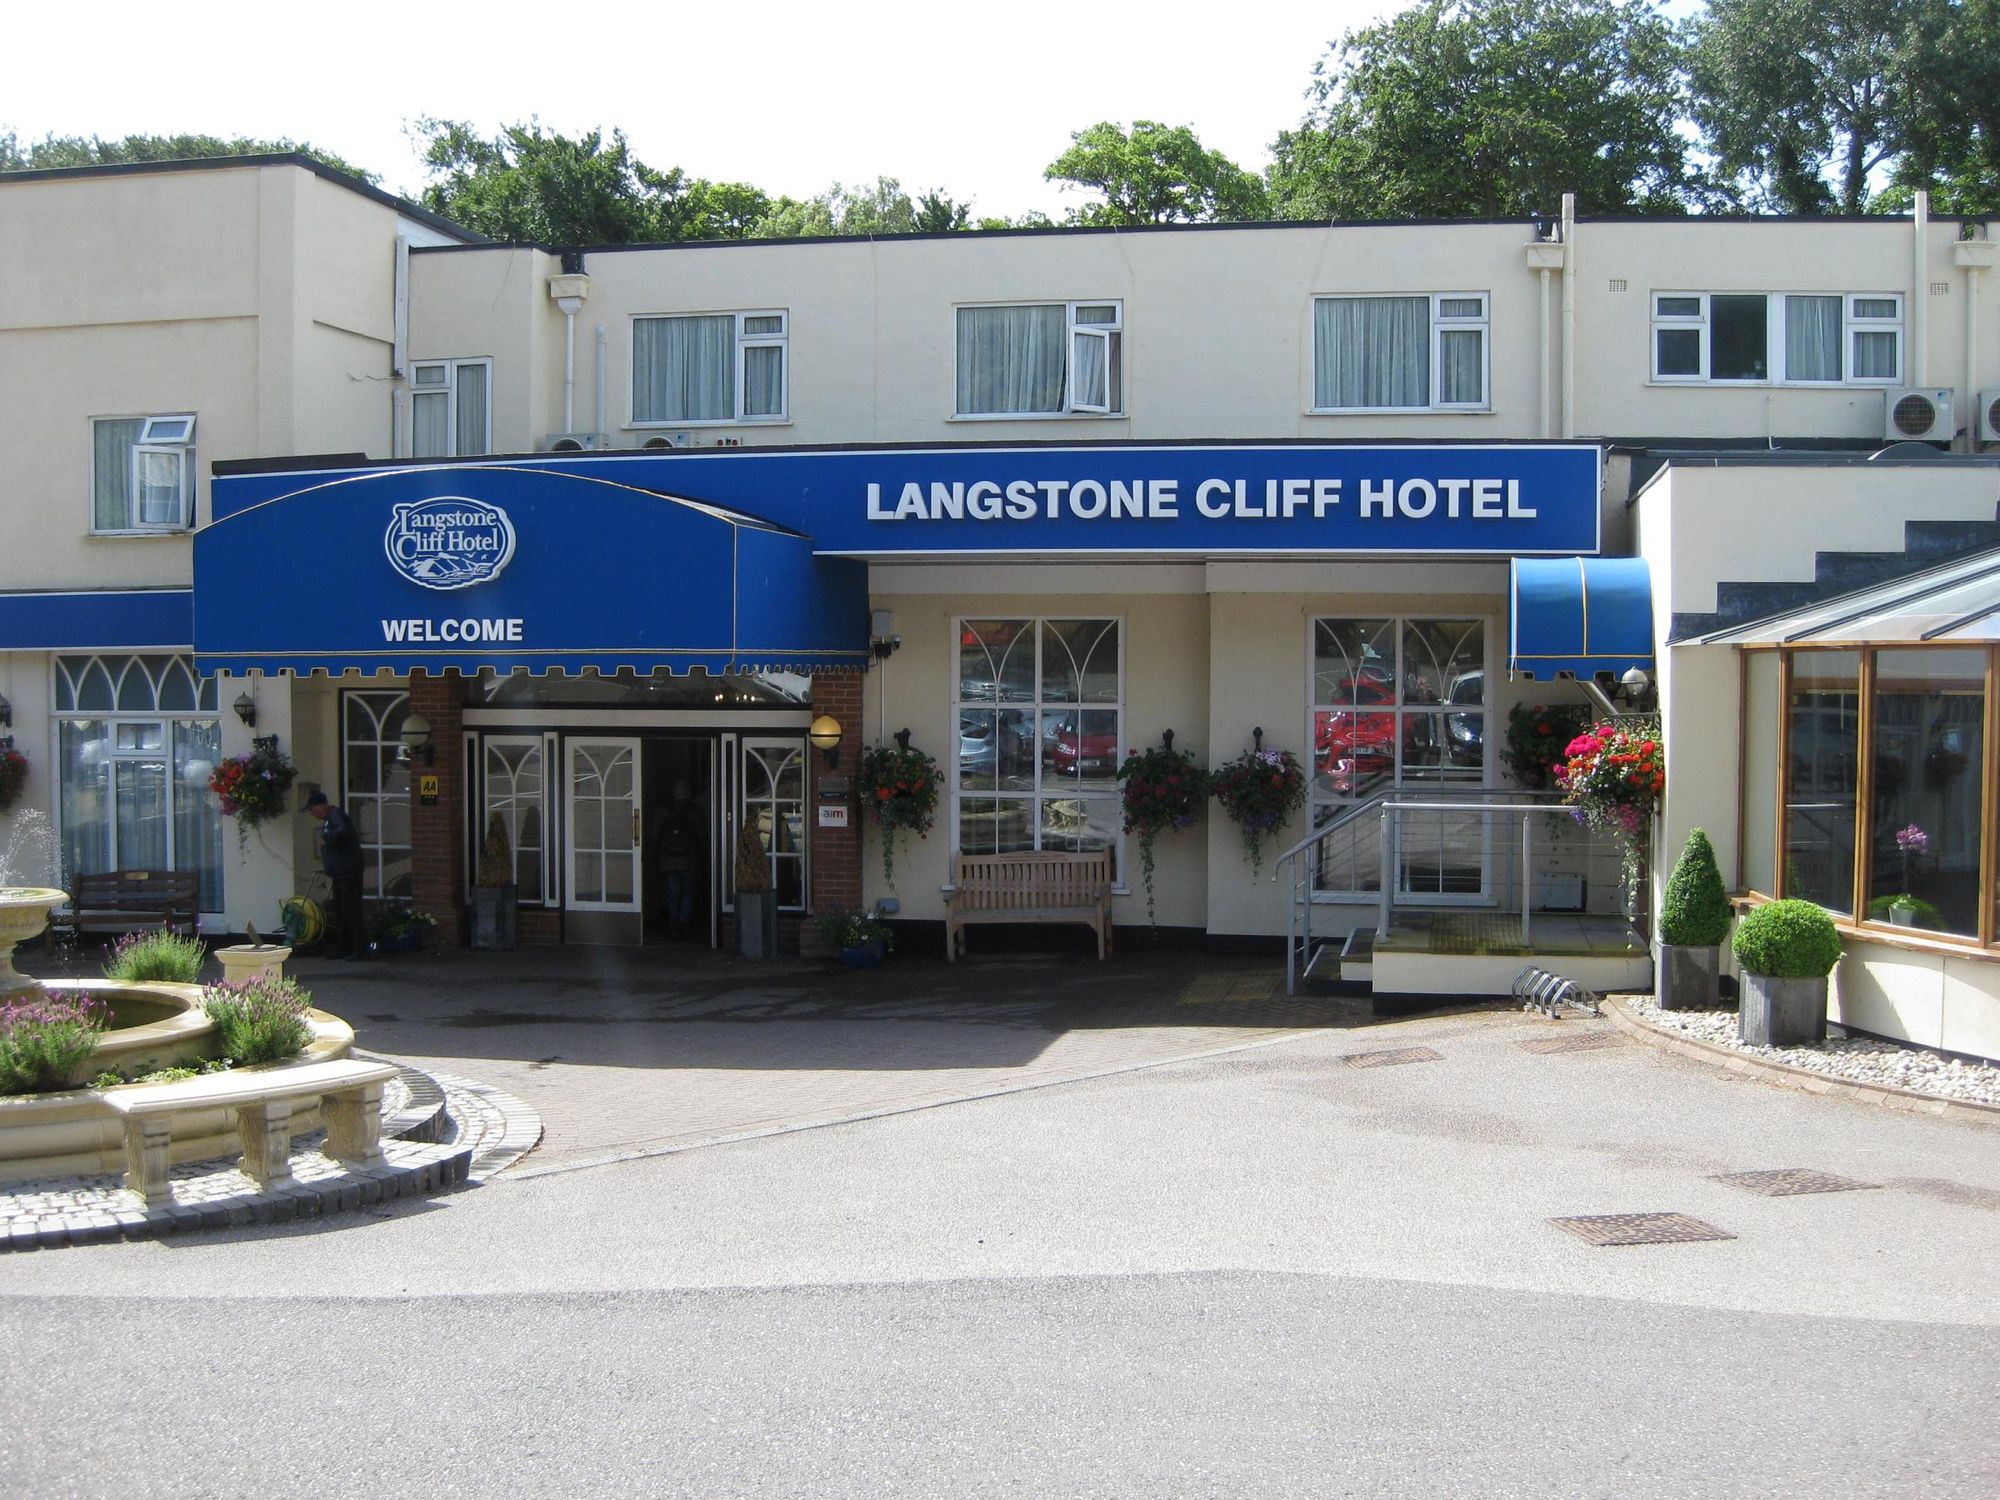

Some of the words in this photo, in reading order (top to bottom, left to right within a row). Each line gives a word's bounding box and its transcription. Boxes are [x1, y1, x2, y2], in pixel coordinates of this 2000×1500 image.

[867, 479, 1180, 520] LANGSTONE
[1195, 478, 1343, 518] CLIFF
[1360, 478, 1538, 518] HOTEL
[399, 509, 498, 536] Langstone
[396, 531, 446, 560] Cliff
[446, 528, 499, 551] Hotel
[381, 618, 524, 642] WELCOME
